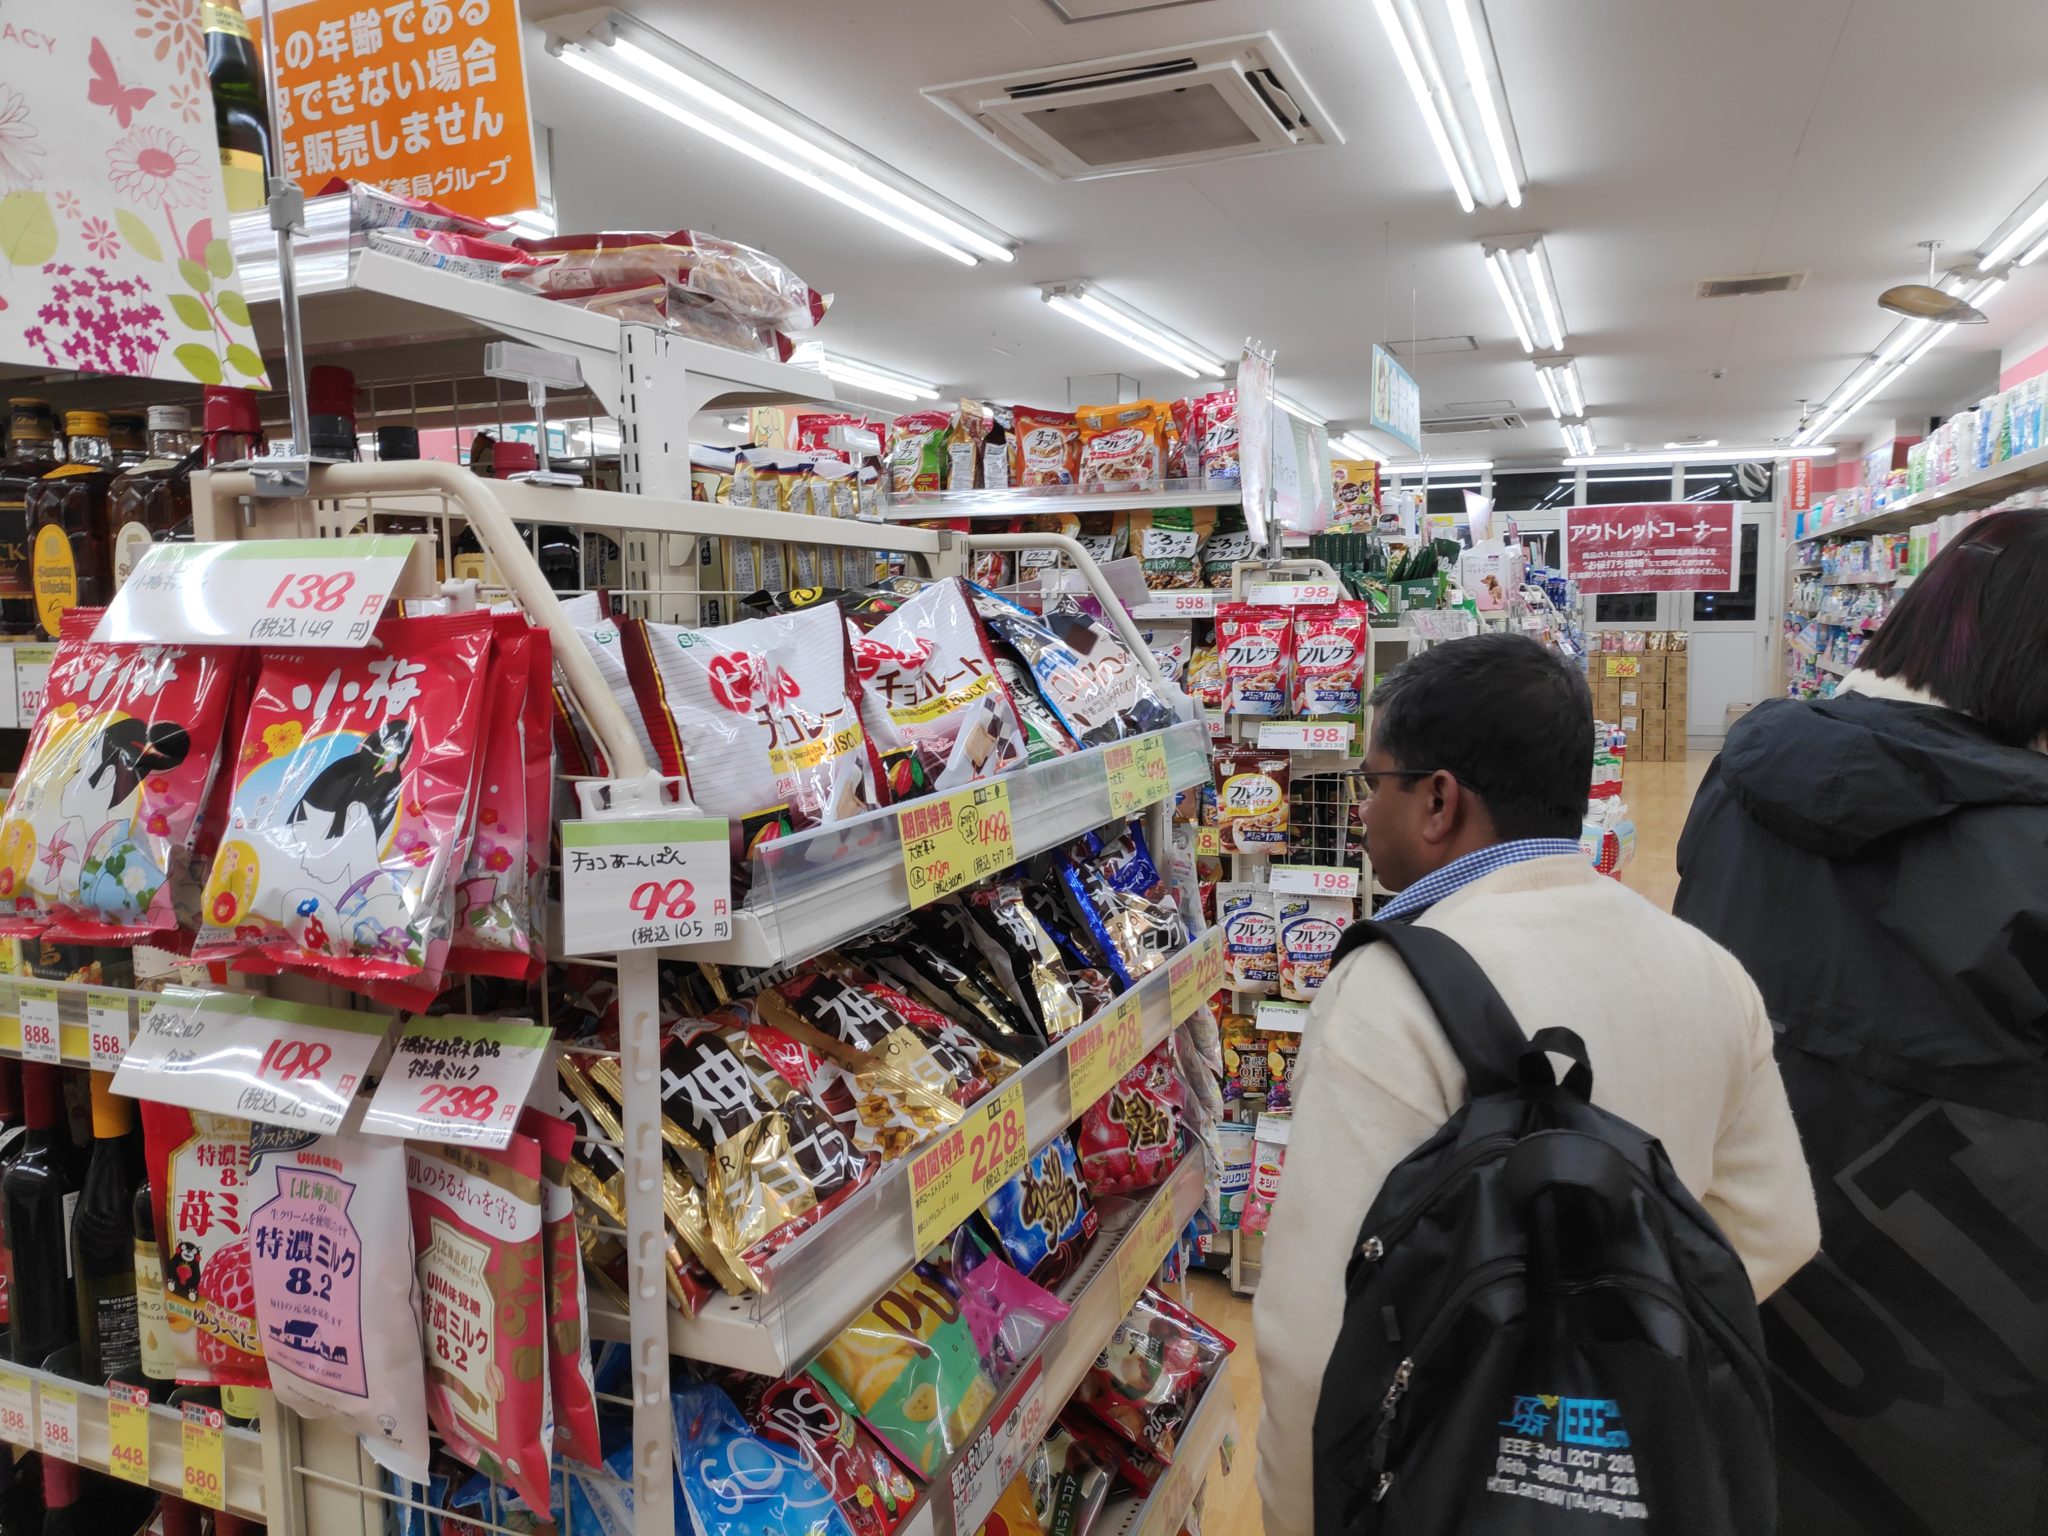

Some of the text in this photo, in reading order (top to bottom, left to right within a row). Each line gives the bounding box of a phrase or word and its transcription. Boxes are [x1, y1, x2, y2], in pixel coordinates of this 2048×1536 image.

[3, 22, 56, 54] ACY
[1204, 427, 1239, 449] フルグ
[1082, 535, 1112, 550] ろっと
[1205, 535, 1250, 550] ごろっと
[1569, 520, 1728, 542] アウトレットコーナー
[267, 571, 355, 612] 138
[360, 593, 384, 616] 円
[1226, 647, 1280, 664] フルグラ
[1298, 646, 1355, 664] フルグラ
[292, 655, 427, 720] 小梅
[900, 800, 953, 842] 期間特売
[571, 845, 687, 873] チョコあーんぱん
[628, 878, 696, 921] 98
[714, 898, 727, 916] 円
[1291, 930, 1336, 943] フルグラ
[256, 1039, 332, 1088] 198
[336, 1073, 357, 1097] 円
[416, 1083, 499, 1122] 238
[500, 1104, 517, 1121] 円
[197, 1144, 250, 1168] 特濃ミ
[912, 1129, 965, 1193] 期間特売
[969, 1109, 1025, 1185] 228円
[407, 1155, 517, 1230] 肌のうるおいを守る
[176, 1188, 249, 1238] 苺ミ
[255, 1226, 356, 1279] 特濃ミルク
[285, 1267, 333, 1303] 8.2
[427, 1270, 482, 1319] UHA味覚糖
[193, 1307, 257, 1351] ゆうべに
[435, 1334, 469, 1373] 8.2
[112, 1444, 143, 1466] 448
[1535, 1444, 1562, 1463] 3rd
[185, 1466, 217, 1491] 680
[1573, 1470, 1607, 1493] April
